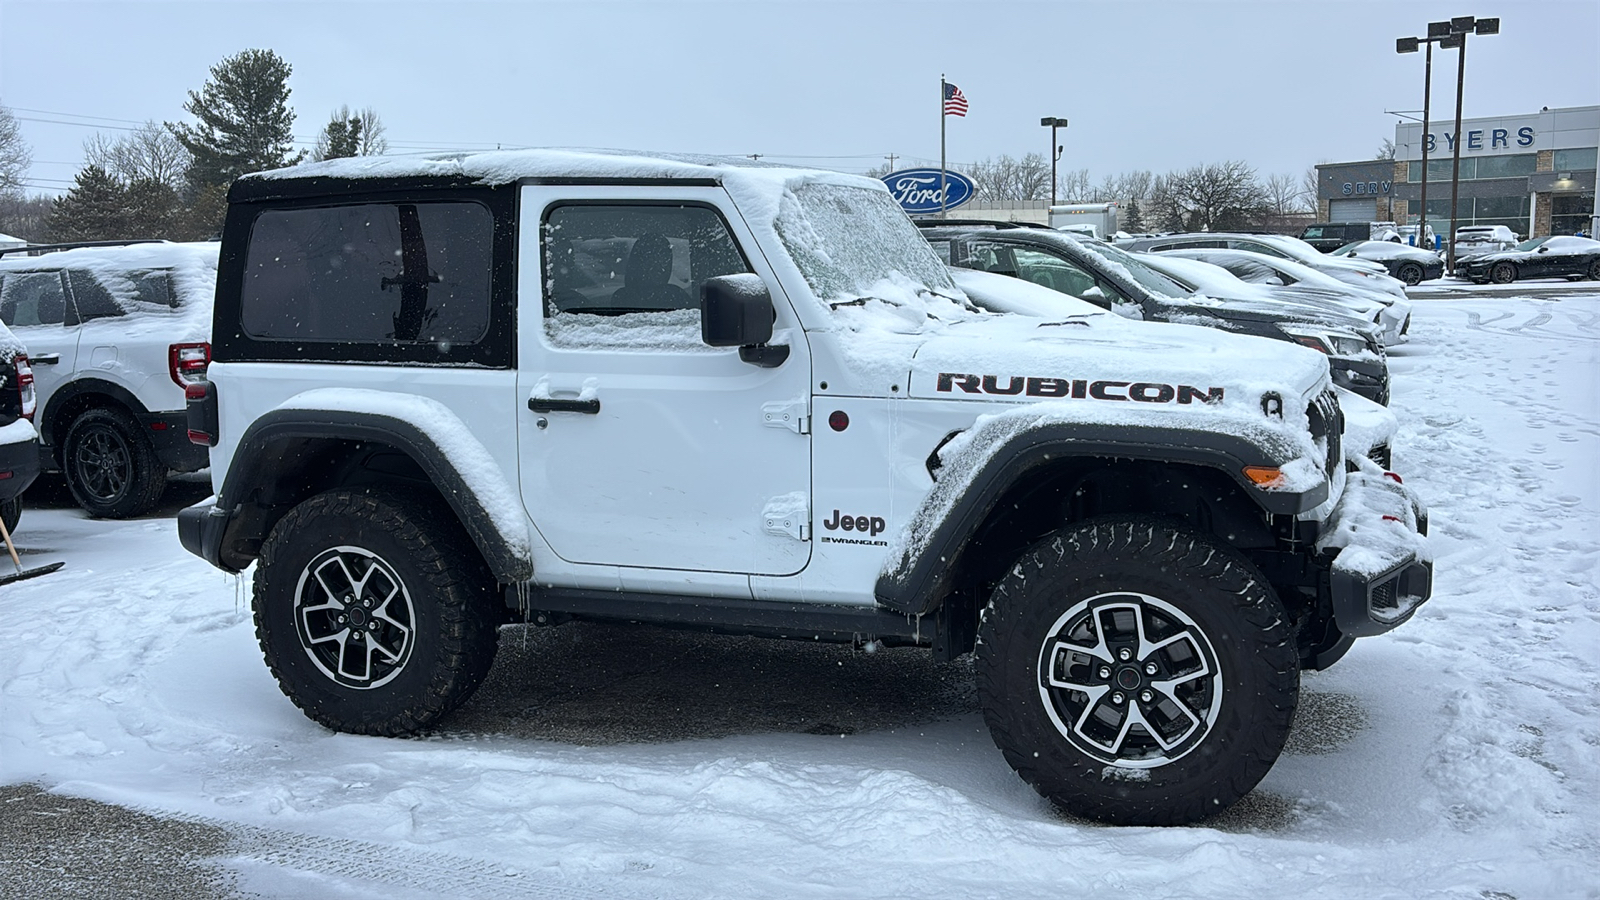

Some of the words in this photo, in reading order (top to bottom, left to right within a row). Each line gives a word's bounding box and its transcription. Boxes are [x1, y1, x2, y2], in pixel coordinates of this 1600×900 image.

[1421, 127, 1534, 152] BYERS
[893, 177, 951, 204] Ford
[1342, 180, 1392, 195] SERV
[936, 373, 1224, 404] RUBICON
[823, 509, 886, 537] Jeep
[831, 537, 888, 547] WRANGLER
